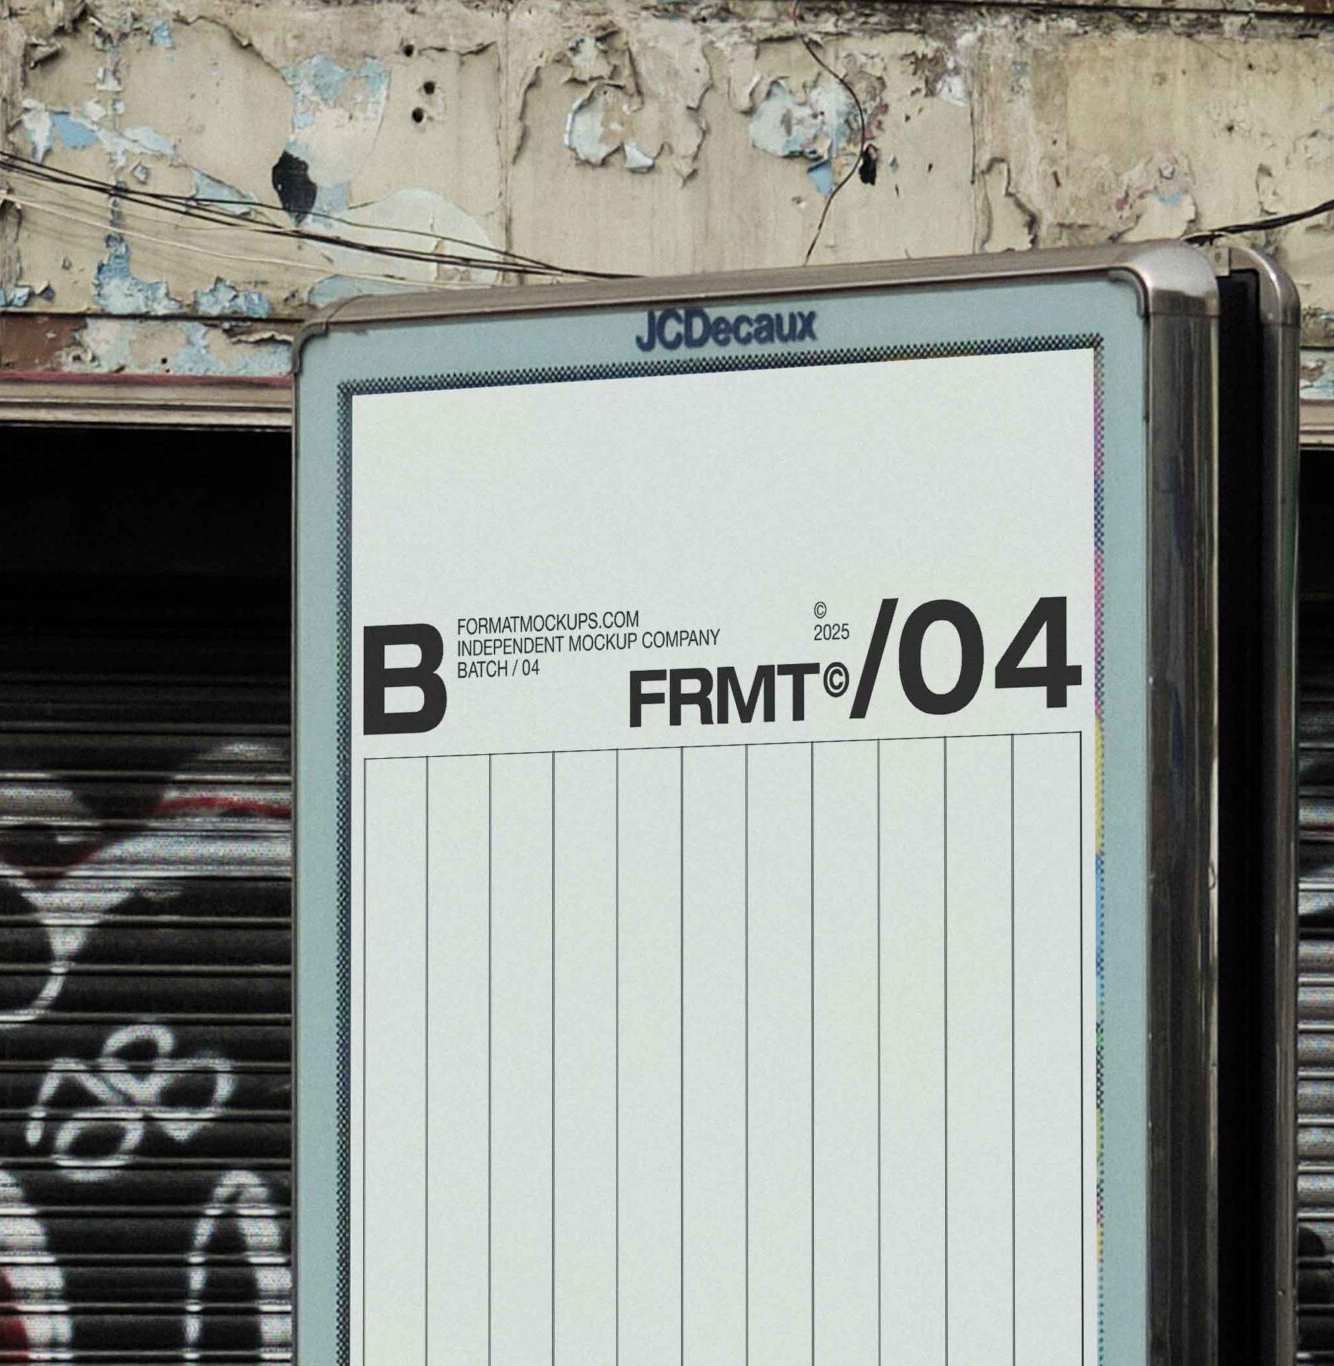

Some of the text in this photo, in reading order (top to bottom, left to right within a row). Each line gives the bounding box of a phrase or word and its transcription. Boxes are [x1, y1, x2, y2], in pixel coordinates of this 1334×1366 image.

[635, 307, 817, 352] JCDecaux
[457, 610, 640, 635] FORMATMOCKUPS.COM
[813, 623, 850, 641] 2025
[457, 628, 721, 657] INDEPENDENT MOCKUP COMPANY
[363, 623, 448, 735] B
[457, 659, 540, 679] BATCH / 04
